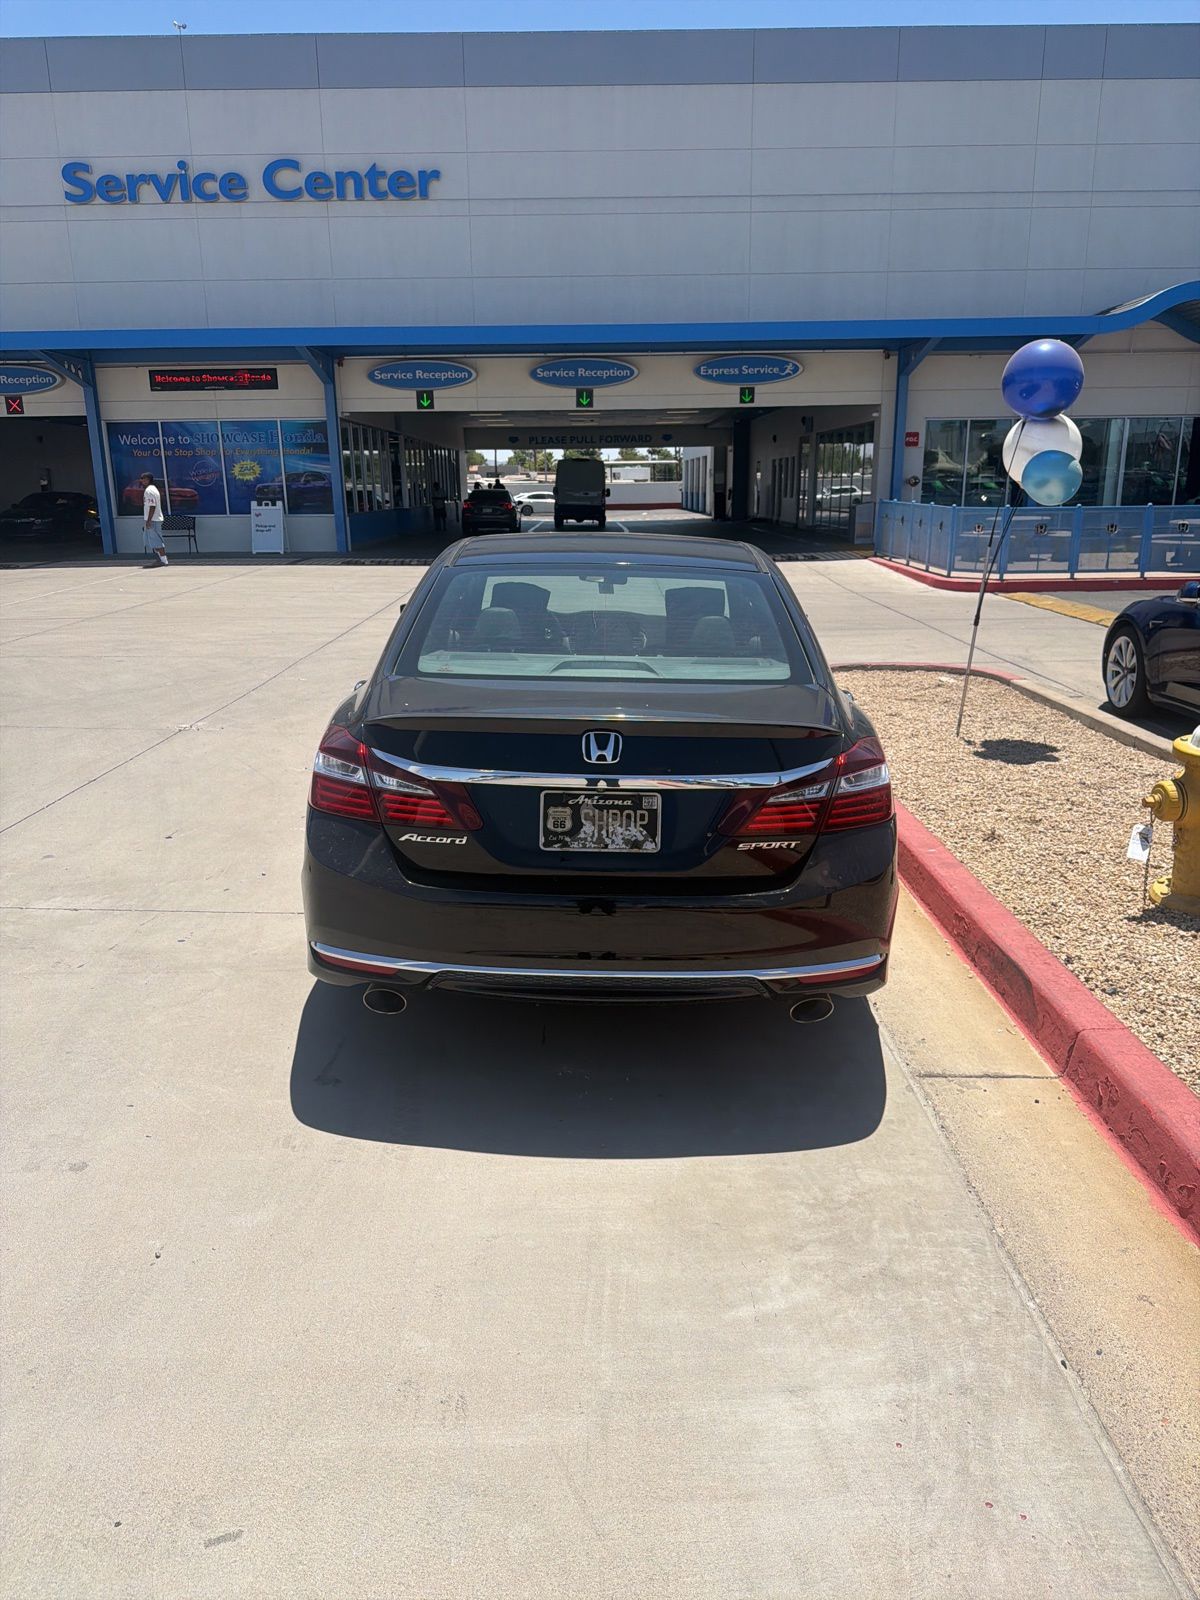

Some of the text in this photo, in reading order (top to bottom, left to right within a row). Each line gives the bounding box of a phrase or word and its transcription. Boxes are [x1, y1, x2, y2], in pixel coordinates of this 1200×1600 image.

[61, 158, 441, 205] Service Center
[373, 369, 469, 381] Service Reception
[535, 367, 631, 379] Service Reception
[700, 365, 780, 377] Express Service
[0, 375, 53, 386] Reception
[155, 375, 190, 383] Welcome
[118, 429, 325, 446] Welcome to SHOWCASE Honda
[528, 434, 653, 445] PLEASE PULL FORWARD
[132, 449, 151, 457] Your
[174, 448, 193, 458] Stop
[195, 447, 217, 457] Shop
[568, 795, 633, 806] Arizona
[552, 820, 566, 829] 66
[398, 833, 468, 845] Accord
[736, 841, 801, 851] SPORT
